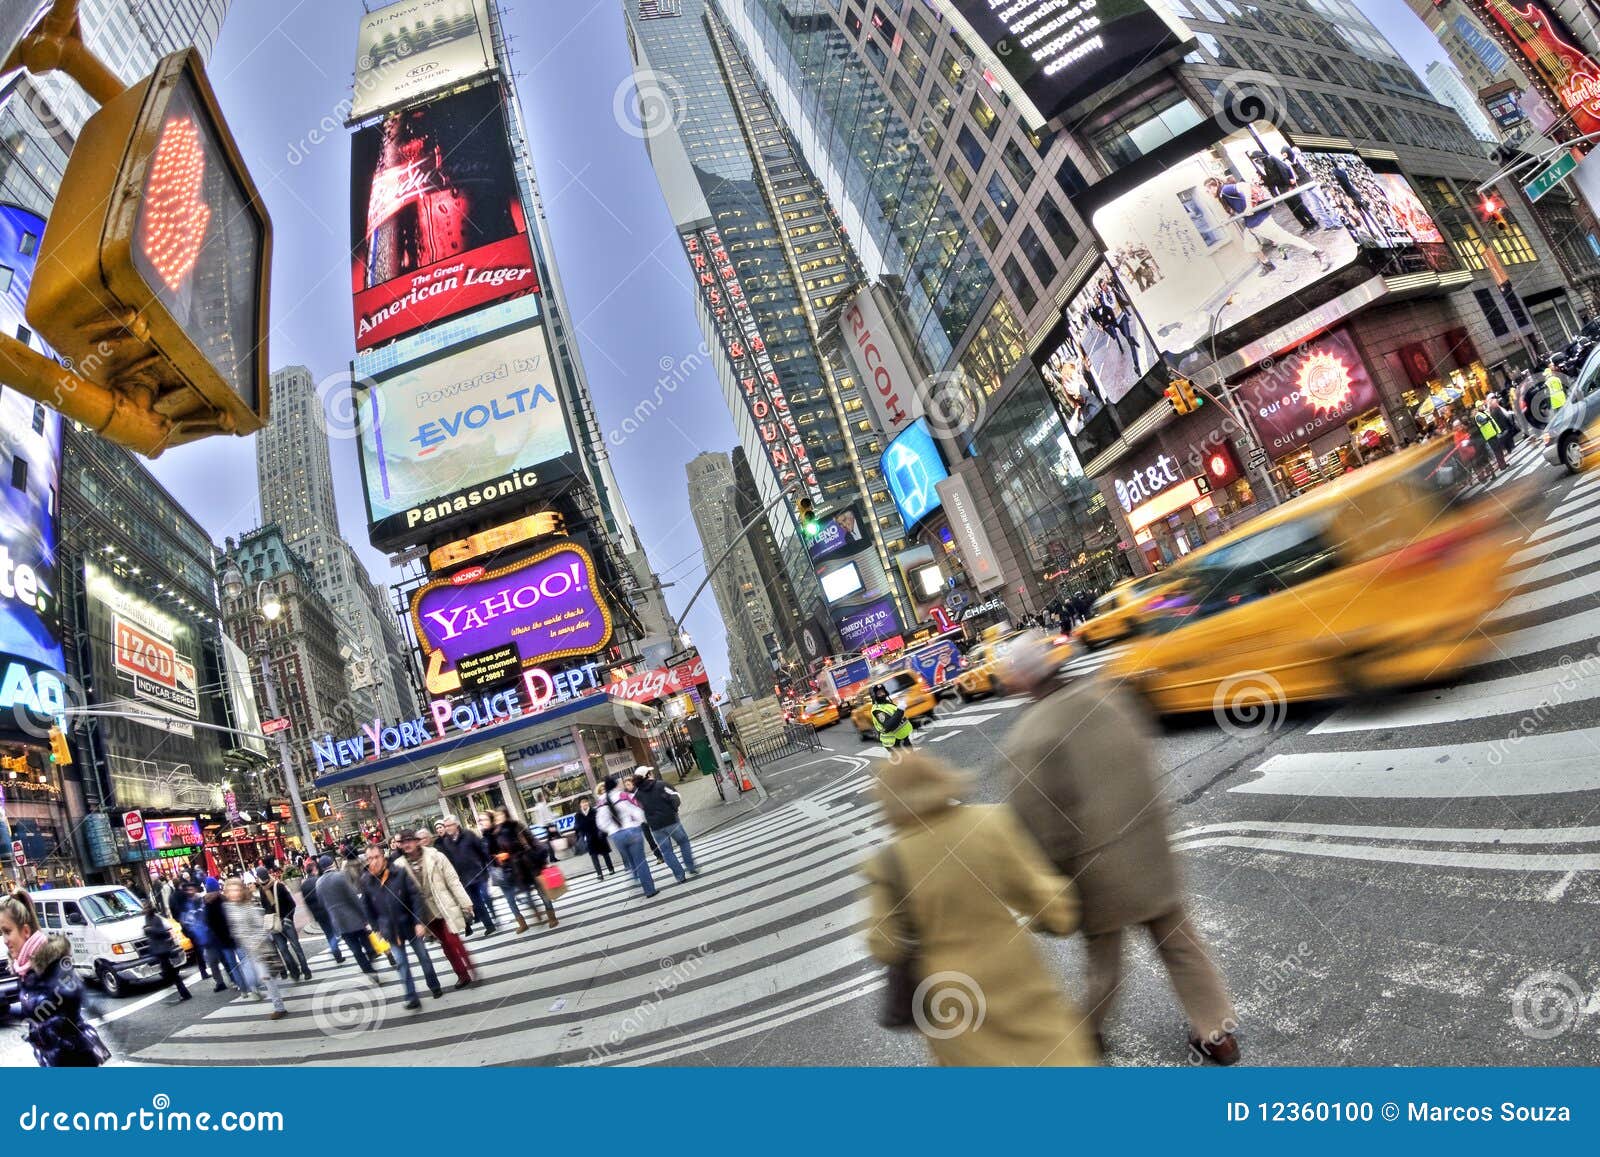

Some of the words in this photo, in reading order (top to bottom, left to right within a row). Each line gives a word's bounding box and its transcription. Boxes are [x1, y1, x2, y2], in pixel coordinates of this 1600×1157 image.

[366, 6, 418, 29] All-New
[1020, 6, 1082, 48] measures
[1079, 0, 1097, 11] to
[1032, 25, 1084, 62] support
[1079, 16, 1101, 31] its
[1043, 35, 1104, 76] economy
[412, 65, 434, 76] KIA
[1562, 82, 1590, 108] Hard
[1538, 177, 1548, 188] 7
[411, 273, 431, 287] The
[433, 264, 464, 278] Great
[687, 239, 728, 318] ERNST
[356, 276, 458, 340] American
[463, 267, 532, 287] Lager
[846, 304, 907, 427] RICOH
[415, 362, 508, 408] Powered
[513, 354, 541, 376] by
[409, 383, 556, 448] EVOLTA
[1273, 418, 1323, 448] europa
[1126, 454, 1178, 504] at&t
[406, 469, 539, 528] Panasonic
[814, 525, 839, 546] LENO
[453, 568, 482, 584] VACANCY
[424, 563, 581, 641] YAHOO!
[964, 599, 1000, 618] CHASE
[532, 622, 542, 630] the
[544, 614, 562, 626] world
[564, 608, 584, 619] checks
[840, 619, 864, 636] COMEDY
[865, 614, 876, 626] AT
[875, 610, 888, 620] 10.
[121, 630, 171, 678] IZOD
[461, 658, 478, 669] What
[480, 655, 494, 664] was
[494, 648, 511, 660] your
[461, 664, 487, 680] favorite
[487, 656, 518, 671] moment
[477, 676, 485, 684] of
[138, 679, 170, 698] INDYCAR
[172, 692, 195, 707] SERIES
[312, 734, 364, 772] NEW
[362, 718, 432, 759] YORK
[431, 689, 521, 738] POLICE
[523, 663, 597, 711] DEPT
[518, 738, 560, 759] POLICE
[388, 778, 425, 797] POLICE
[169, 823, 195, 836] duane
[556, 816, 575, 830] YP
